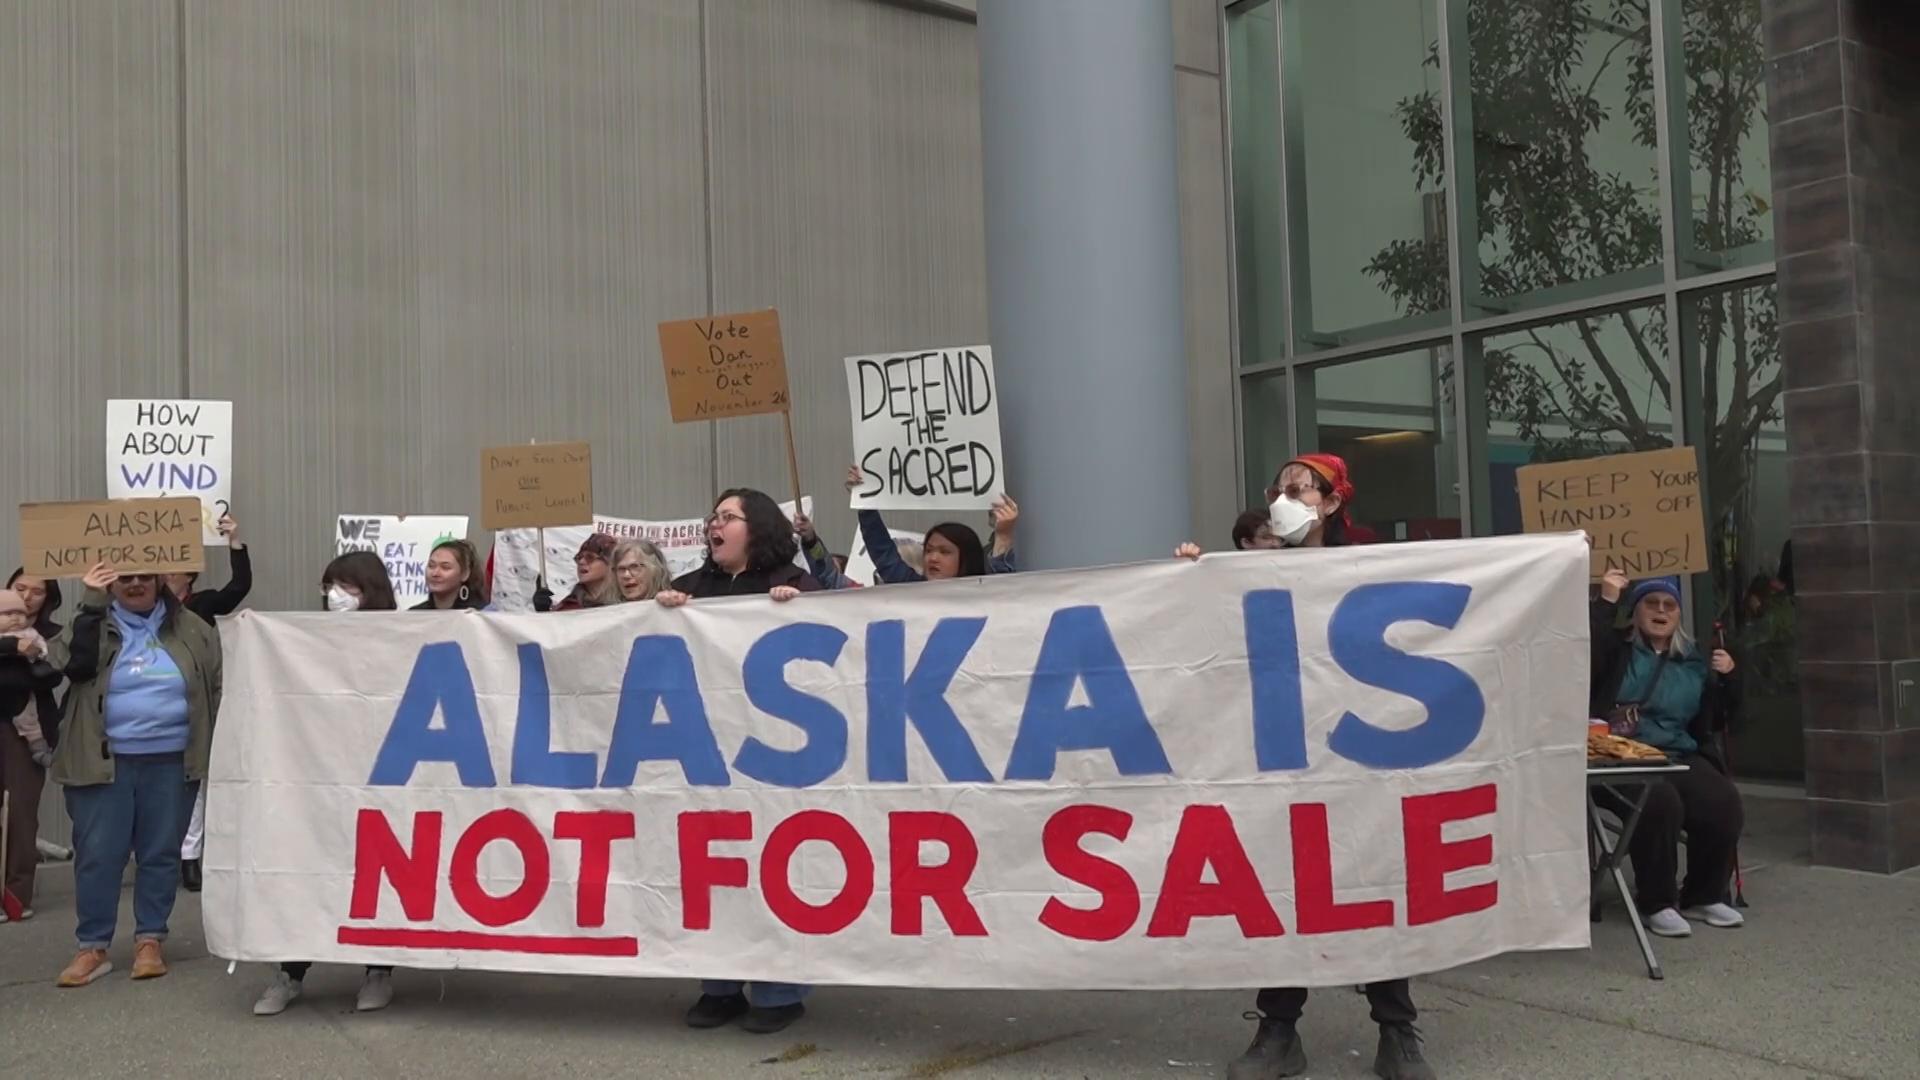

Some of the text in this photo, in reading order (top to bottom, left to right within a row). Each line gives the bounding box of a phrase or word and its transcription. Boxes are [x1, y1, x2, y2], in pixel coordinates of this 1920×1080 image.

[695, 320, 751, 341] Vote
[708, 343, 752, 365] Dan
[716, 373, 752, 390] Out
[857, 350, 992, 422] DEFEND
[136, 402, 201, 426] HOW
[901, 415, 949, 446] THE
[121, 431, 215, 457] ABOUT
[120, 461, 218, 490] WIND
[859, 441, 996, 498] SACRED
[1537, 469, 1699, 503] KEEP YOUR
[1539, 494, 1696, 529] HANDS OFF
[339, 518, 381, 541] WE
[597, 521, 644, 538] DEFEND
[664, 525, 703, 539] SACRE
[1591, 530, 1640, 550] LIC
[44, 543, 191, 568] NOT FOR SALE
[384, 542, 418, 558] EAT
[1604, 533, 1690, 575] ANDS!
[386, 560, 425, 577] RINK
[373, 584, 1481, 787] ALASKA IS
[350, 784, 1497, 941] NOT FOR SALE
